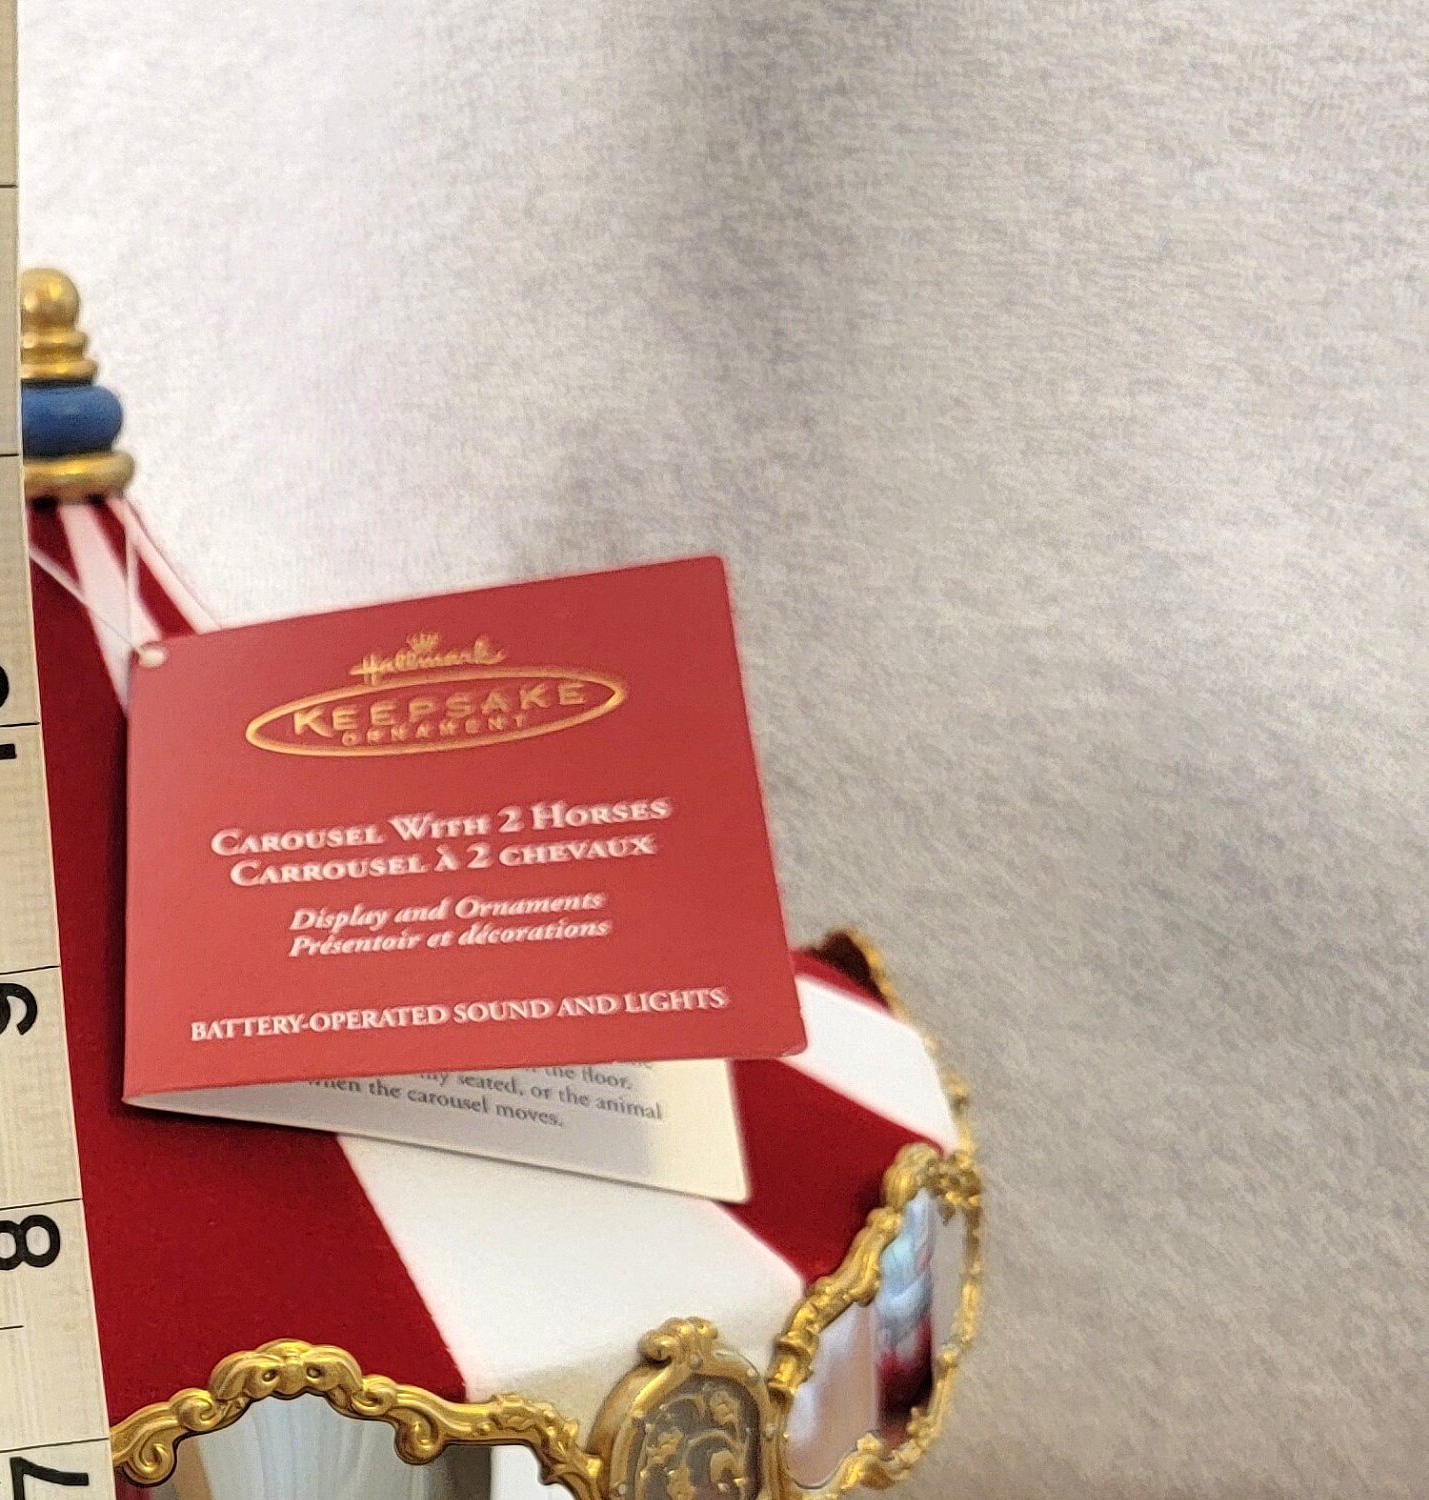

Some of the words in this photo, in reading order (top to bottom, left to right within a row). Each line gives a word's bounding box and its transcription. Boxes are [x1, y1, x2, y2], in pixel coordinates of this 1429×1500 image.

[349, 634, 506, 685] Hallmark
[293, 681, 588, 738] KEEPSAKE
[341, 713, 524, 747] ORNAMENT
[498, 805, 525, 836] 2
[467, 842, 492, 869] 2
[290, 905, 388, 932] Display
[395, 898, 449, 925] and
[454, 891, 609, 920] Ornaments
[288, 931, 420, 958] Présentoir
[427, 931, 451, 949] et
[459, 918, 612, 946] décorations
[191, 1004, 449, 1042] BATTERY-OPERATED
[453, 998, 551, 1024] SOUND
[557, 993, 618, 1018] AND
[624, 986, 729, 1013] LIGHTS
[369, 1079, 401, 1099] the
[407, 1086, 489, 1114] carousel
[496, 1103, 564, 1128] moves.
[457, 1074, 524, 1097] seated,
[530, 1086, 551, 1099] or
[559, 1085, 591, 1108] the
[596, 1099, 664, 1121] animal
